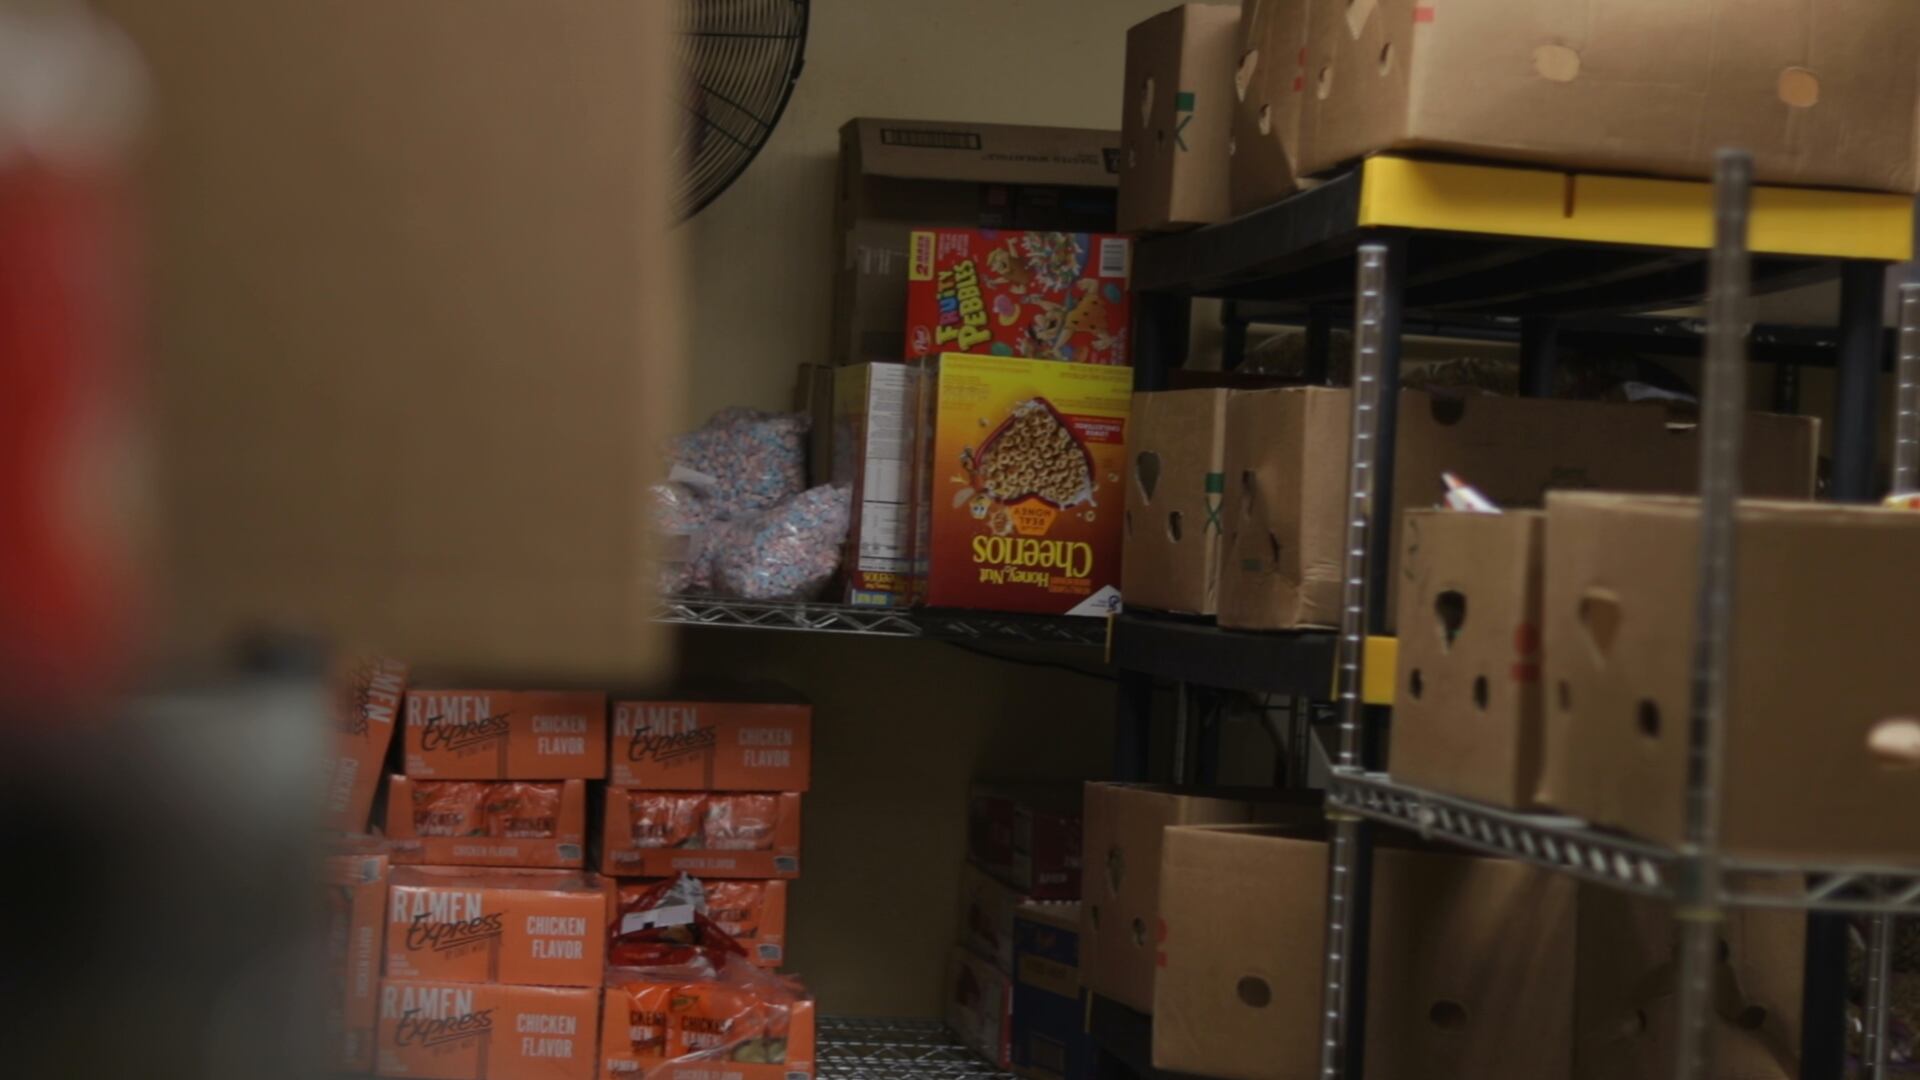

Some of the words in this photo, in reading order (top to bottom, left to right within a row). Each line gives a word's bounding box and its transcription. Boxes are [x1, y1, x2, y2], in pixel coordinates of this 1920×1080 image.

[953, 259, 992, 350] PEBBLES
[972, 536, 1093, 578] Cheerios
[979, 567, 1005, 584] Nut
[1007, 568, 1049, 587] Honey
[407, 695, 491, 726] RAMEN
[531, 714, 587, 733] CHICKEN
[614, 706, 697, 737] RAMEN
[421, 710, 512, 752] Express
[628, 725, 716, 762] Express
[737, 727, 793, 746] CHICKEN
[537, 736, 585, 755] FLAVOR
[743, 749, 790, 768] FLAVOR
[391, 890, 482, 923] RAMEN
[406, 911, 504, 952] Express
[526, 915, 586, 936] CHICKEN
[532, 938, 583, 959] FLAVOR
[381, 986, 474, 1019] RAMEN
[395, 1008, 494, 1047] Express
[516, 1013, 577, 1035] CHICKEN
[522, 1037, 574, 1058] FLAVOR
